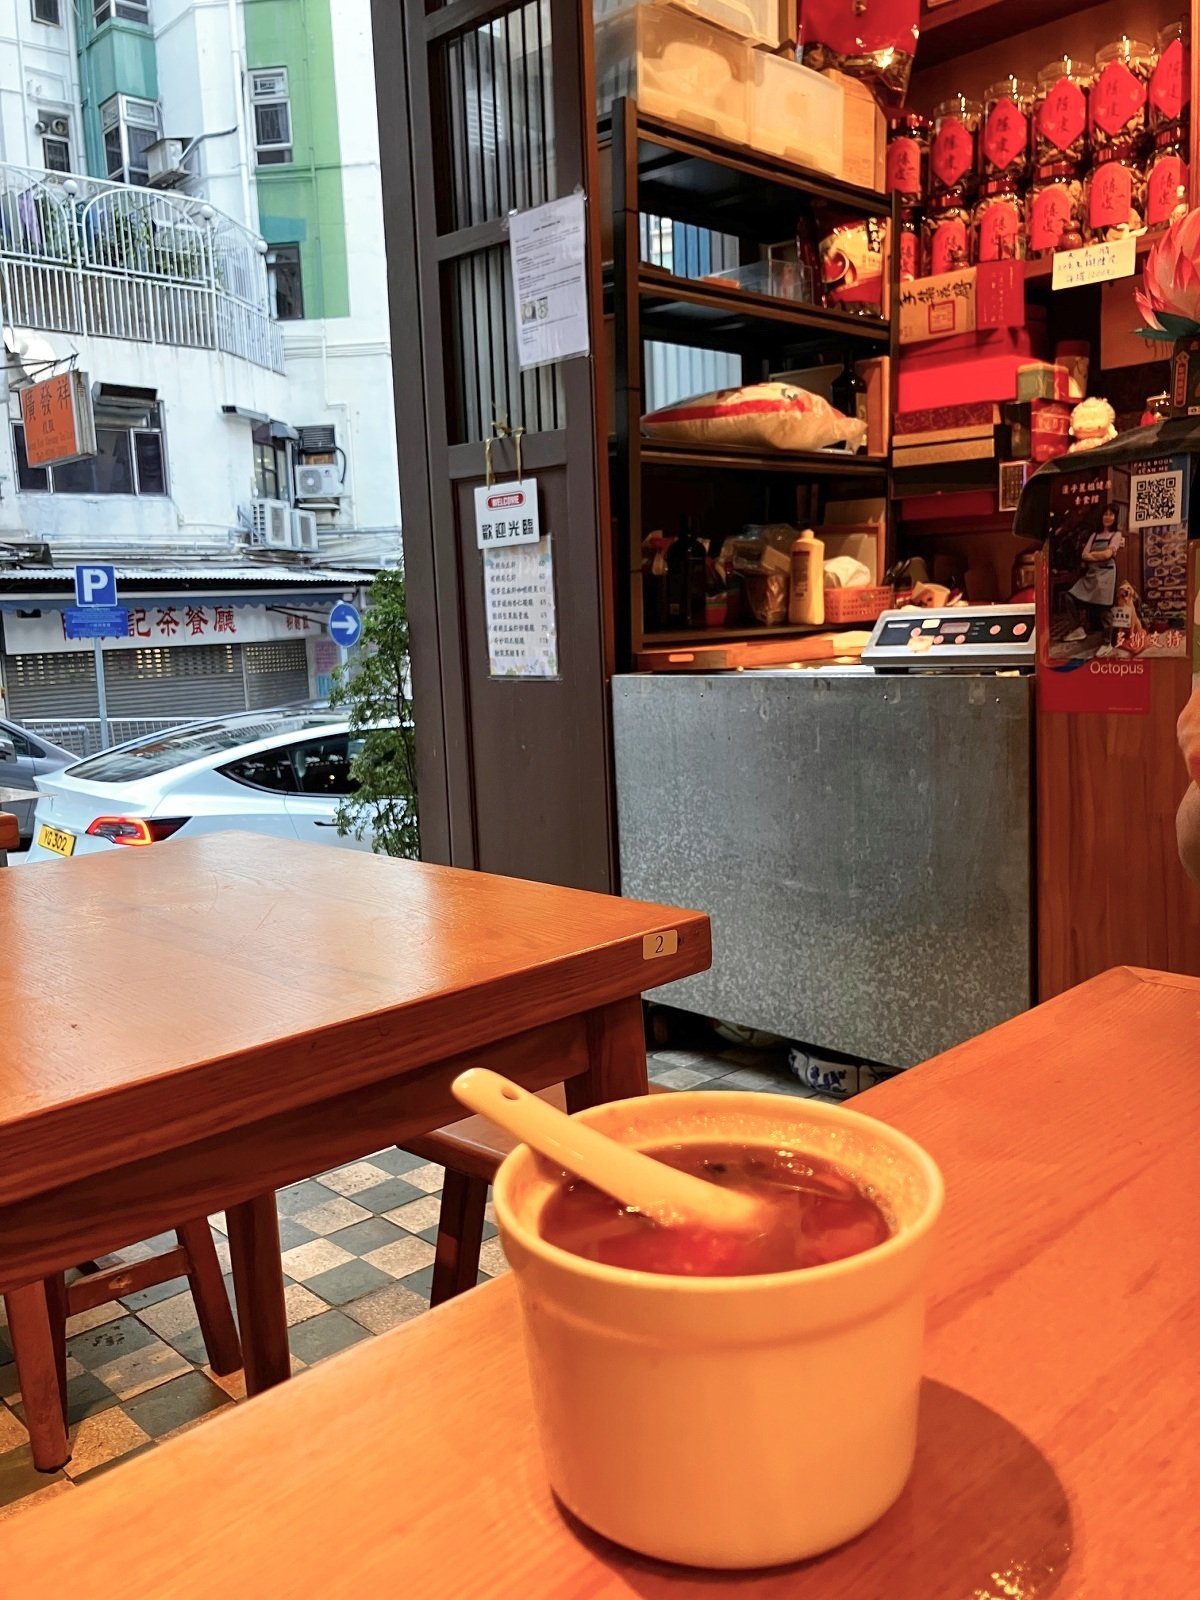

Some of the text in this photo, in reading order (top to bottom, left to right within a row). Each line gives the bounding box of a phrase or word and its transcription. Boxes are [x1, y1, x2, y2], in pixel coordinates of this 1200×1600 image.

[492, 495, 520, 508] WELCOME
[482, 518, 534, 541] 歡迎光臨
[82, 568, 109, 603] P
[1114, 626, 1183, 650] 多謝支持
[1090, 661, 1144, 677] Octopus
[52, 832, 68, 851] 302
[655, 935, 664, 954] 2
